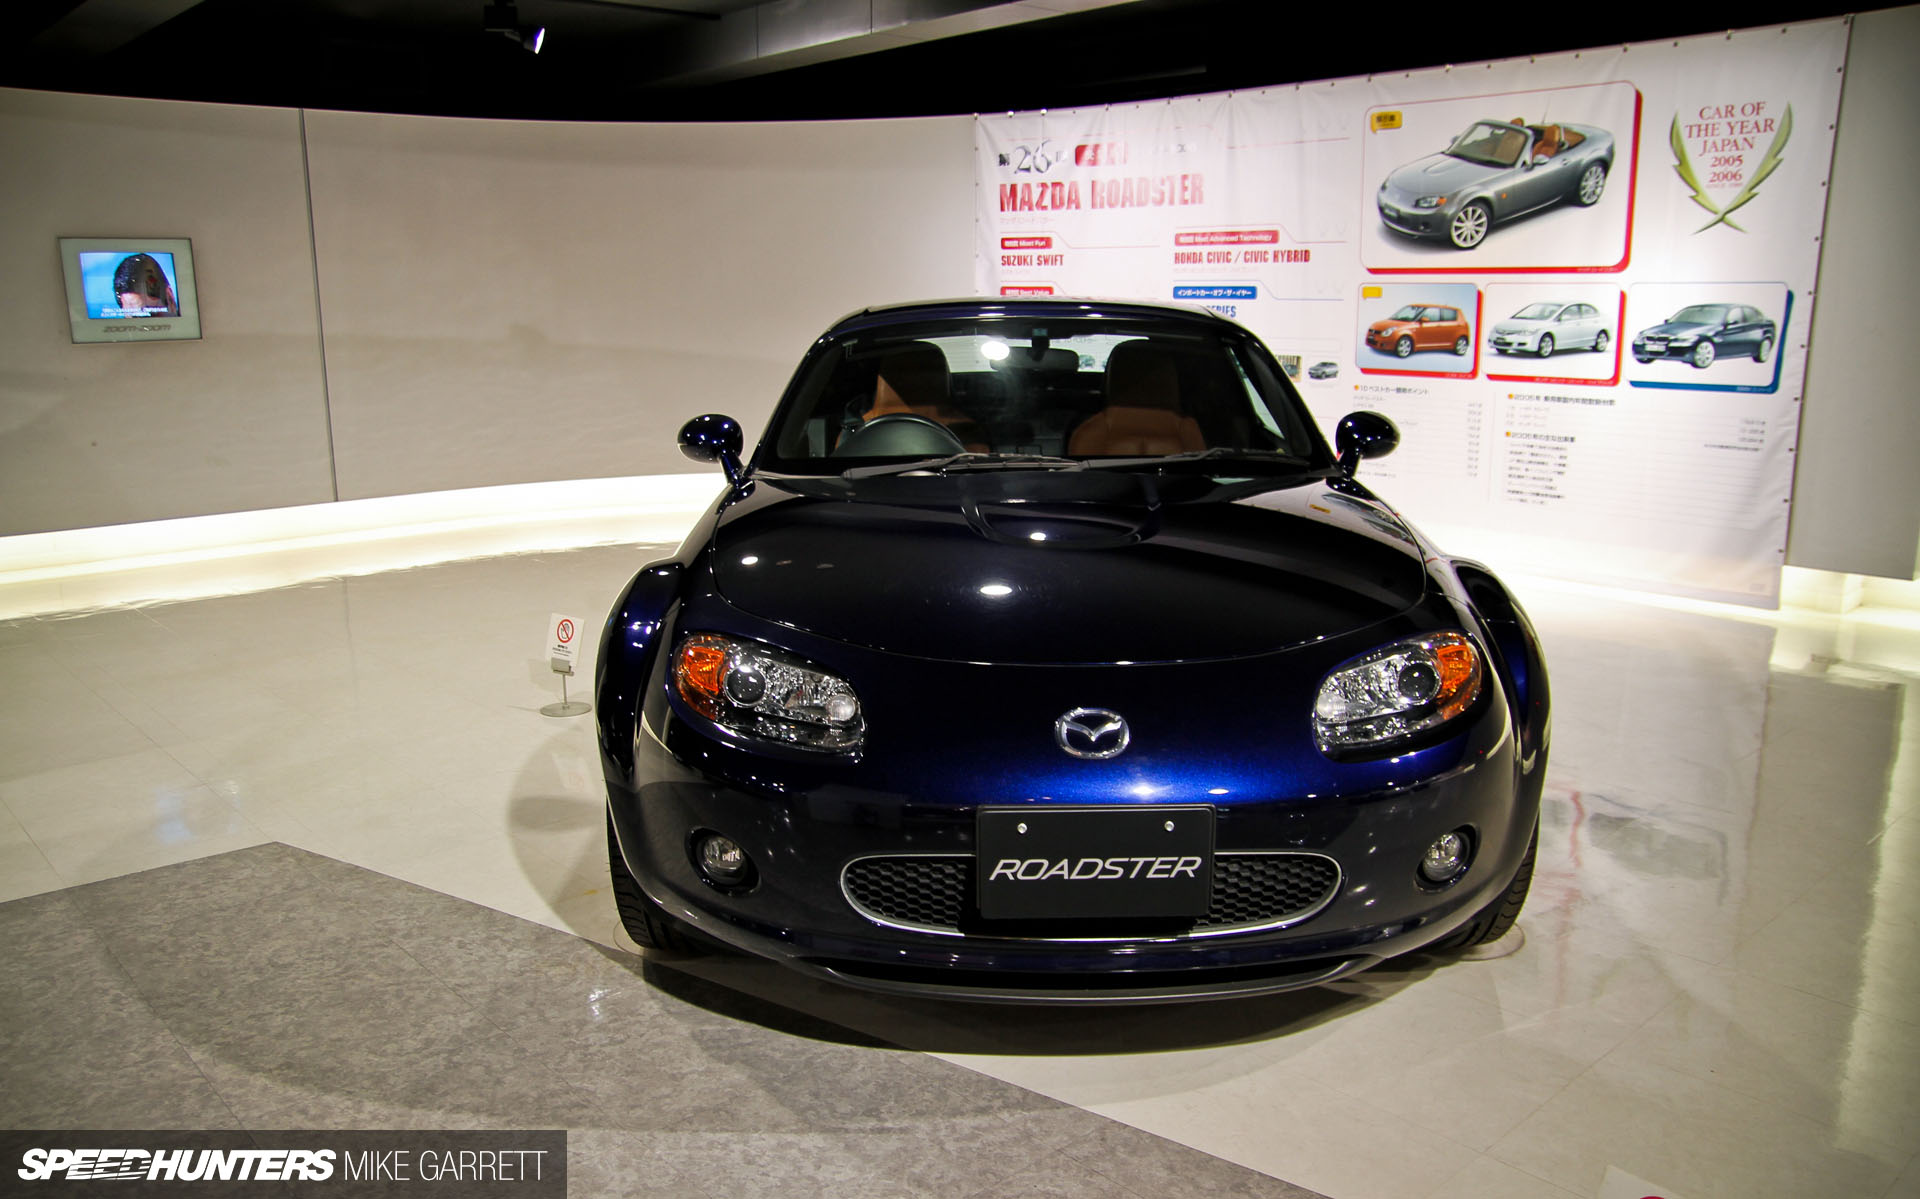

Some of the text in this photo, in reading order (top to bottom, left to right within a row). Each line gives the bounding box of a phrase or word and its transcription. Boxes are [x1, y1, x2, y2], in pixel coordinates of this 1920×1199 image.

[1699, 101, 1767, 120] CAR OF
[1685, 118, 1775, 138] THE YEAR
[1699, 136, 1756, 157] JAPAN
[1710, 155, 1743, 168] 2005
[1709, 169, 1743, 183] 2006
[1000, 174, 1204, 212] MAZDA ROADSTER
[1001, 254, 1064, 266] SUZUKI SWIFT
[1174, 251, 1203, 264] HONDA
[1207, 251, 1232, 263] CIVIC
[1244, 250, 1269, 263] CIVIC
[1273, 249, 1311, 262] HYBRID
[989, 856, 1202, 880] ROADSTER
